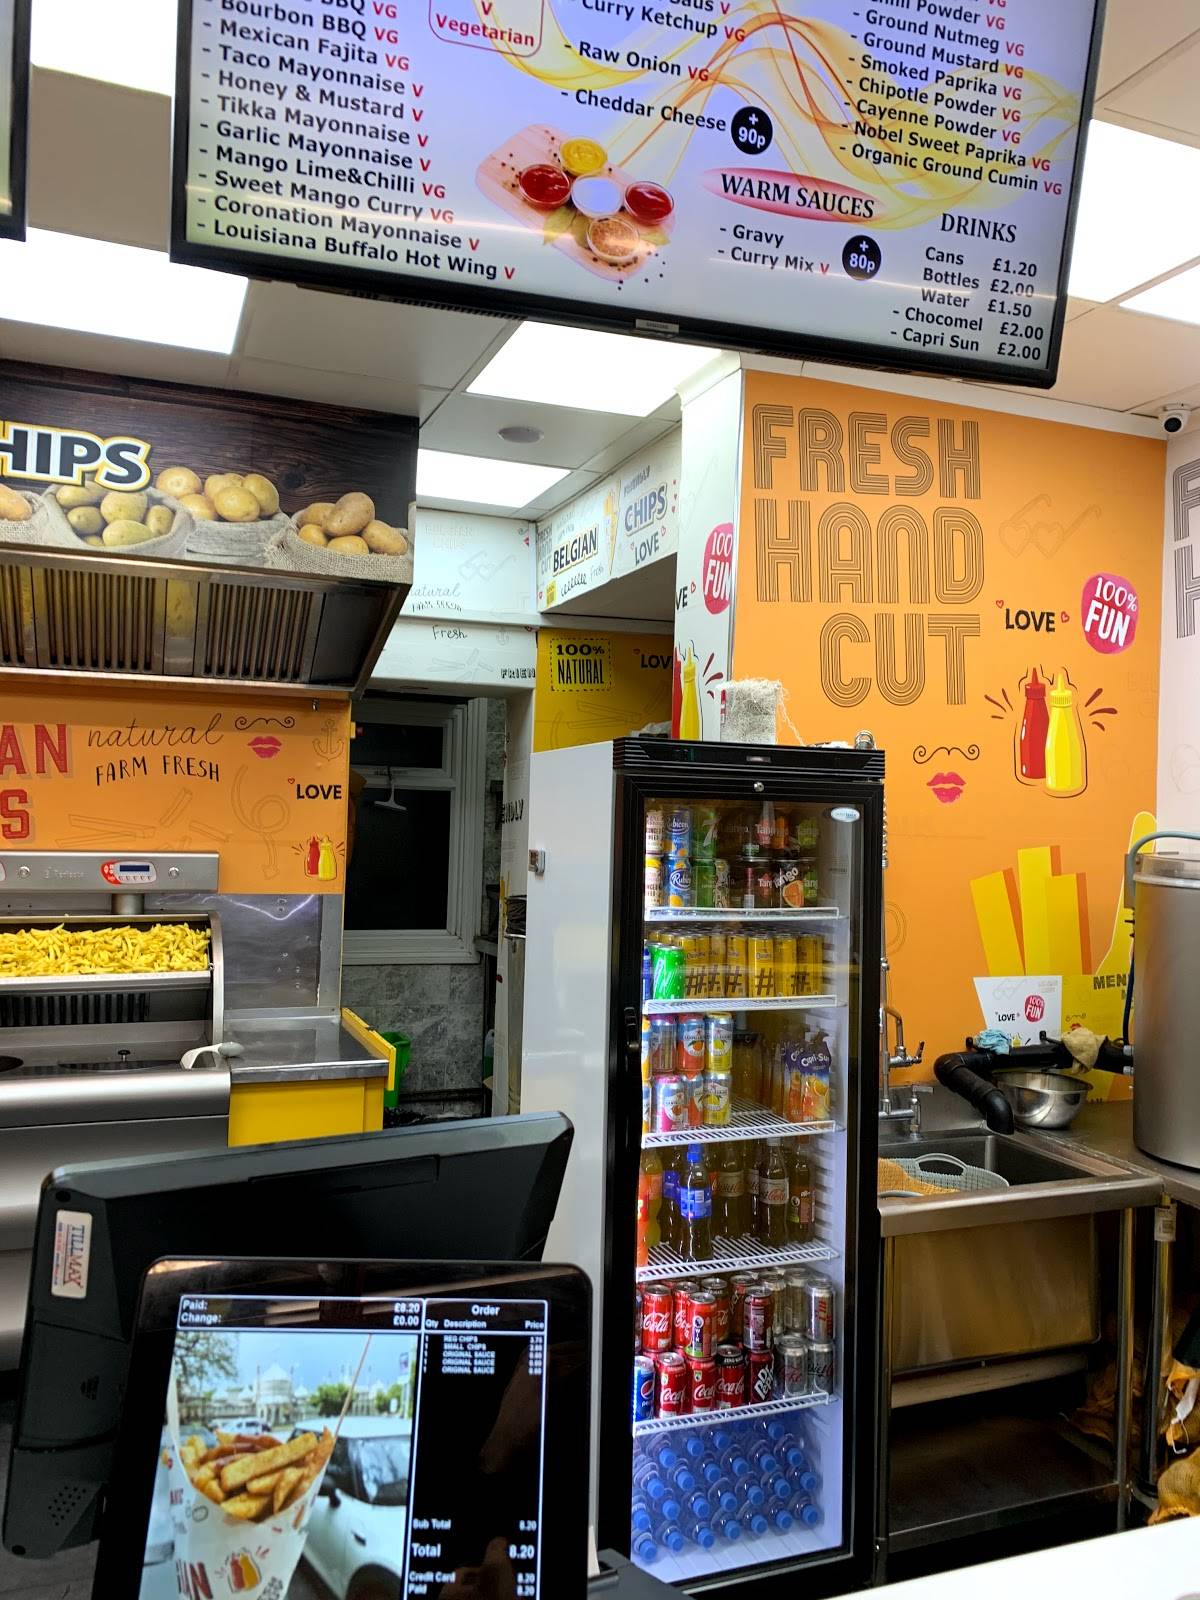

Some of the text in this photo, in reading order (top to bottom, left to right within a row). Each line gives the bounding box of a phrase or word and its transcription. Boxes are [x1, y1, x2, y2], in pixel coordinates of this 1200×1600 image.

[221, 0, 399, 44] Bourbon BBQ VG
[372, 2, 398, 19] VG
[481, 1, 493, 16] V
[582, 0, 746, 42] Curry Ketchup VG
[720, 2, 730, 15] V
[916, 0, 981, 25] Powder
[986, 14, 1006, 31] VG
[220, 19, 411, 71] Mexican Fajita VG
[436, 14, 536, 47] Vegetarian
[866, 9, 1025, 57] Ground Nutmeg VG
[218, 44, 424, 98] Taco Mayonnaise V
[579, 41, 709, 82] Raw Onion VG
[864, 32, 1025, 80] Ground Mustard VG
[861, 54, 1023, 101] Smoked Paprika VG
[218, 70, 424, 123] Honey & Mustard V
[575, 89, 727, 131] Cheddar Cheese
[859, 77, 1022, 123] Chipotle Powder VG
[217, 95, 429, 148] Tikka Mayonnaise V
[738, 126, 767, 149] 90p
[857, 99, 1022, 145] Cayenne Powder VG
[217, 120, 432, 172] Garlic Mayonnaise V
[854, 121, 1052, 172] Nobel Sweet Paprika VG
[216, 145, 446, 199] Mango Lime&Chilli VG
[852, 143, 1063, 195] Organic Ground Cumin VG
[215, 171, 455, 224] Sweet Mango Curry VG
[720, 173, 875, 219] WARM SAUCES
[214, 195, 480, 252] Coronation Mayonnaise V
[733, 224, 784, 248] Gravy
[940, 213, 1018, 244] DRINKS
[214, 220, 516, 281] Louisiana Buffalo Hot Wing V
[731, 246, 829, 274] Curry Mix V
[849, 253, 876, 273] 80p
[925, 246, 1038, 278] Cans £1.20
[923, 267, 1035, 298] Bottles £2.00
[921, 288, 1032, 318] Water £1.50
[904, 307, 1044, 341] Chocomel £2.00
[902, 327, 1041, 361] Capri Sun £2.00
[752, 402, 982, 500] FRESH
[624, 485, 668, 533] CHIPS
[553, 527, 598, 574] BELGIAN
[634, 531, 660, 567] LOVE
[753, 497, 985, 605] HAND
[1094, 576, 1139, 613] 100%
[432, 624, 468, 641] Fresh
[1004, 608, 1057, 634] LOVE
[1084, 599, 1132, 648] FUN
[556, 643, 606, 657] 100%
[640, 654, 673, 670] LOV
[820, 612, 981, 708] CUT
[557, 657, 605, 685] NATURAL
[87, 712, 225, 749] natural
[96, 754, 220, 787] FARM FRESH
[296, 783, 344, 801] LOVE
[998, 1013, 1016, 1022] LOVE
[1025, 1006, 1043, 1020] FUN
[180, 1312, 419, 1327] Change: £0.00
[182, 1299, 420, 1314] Paid: £8.20
[471, 1304, 501, 1317] Order
[425, 1318, 545, 1330] Qty Description Price
[430, 1518, 452, 1530] Total
[519, 1519, 537, 1532] 8.20
[411, 1542, 535, 1559] Total 8.20
[407, 1583, 428, 1595] Paid
[408, 1571, 434, 1583] Credit
[435, 1571, 456, 1583] Card
